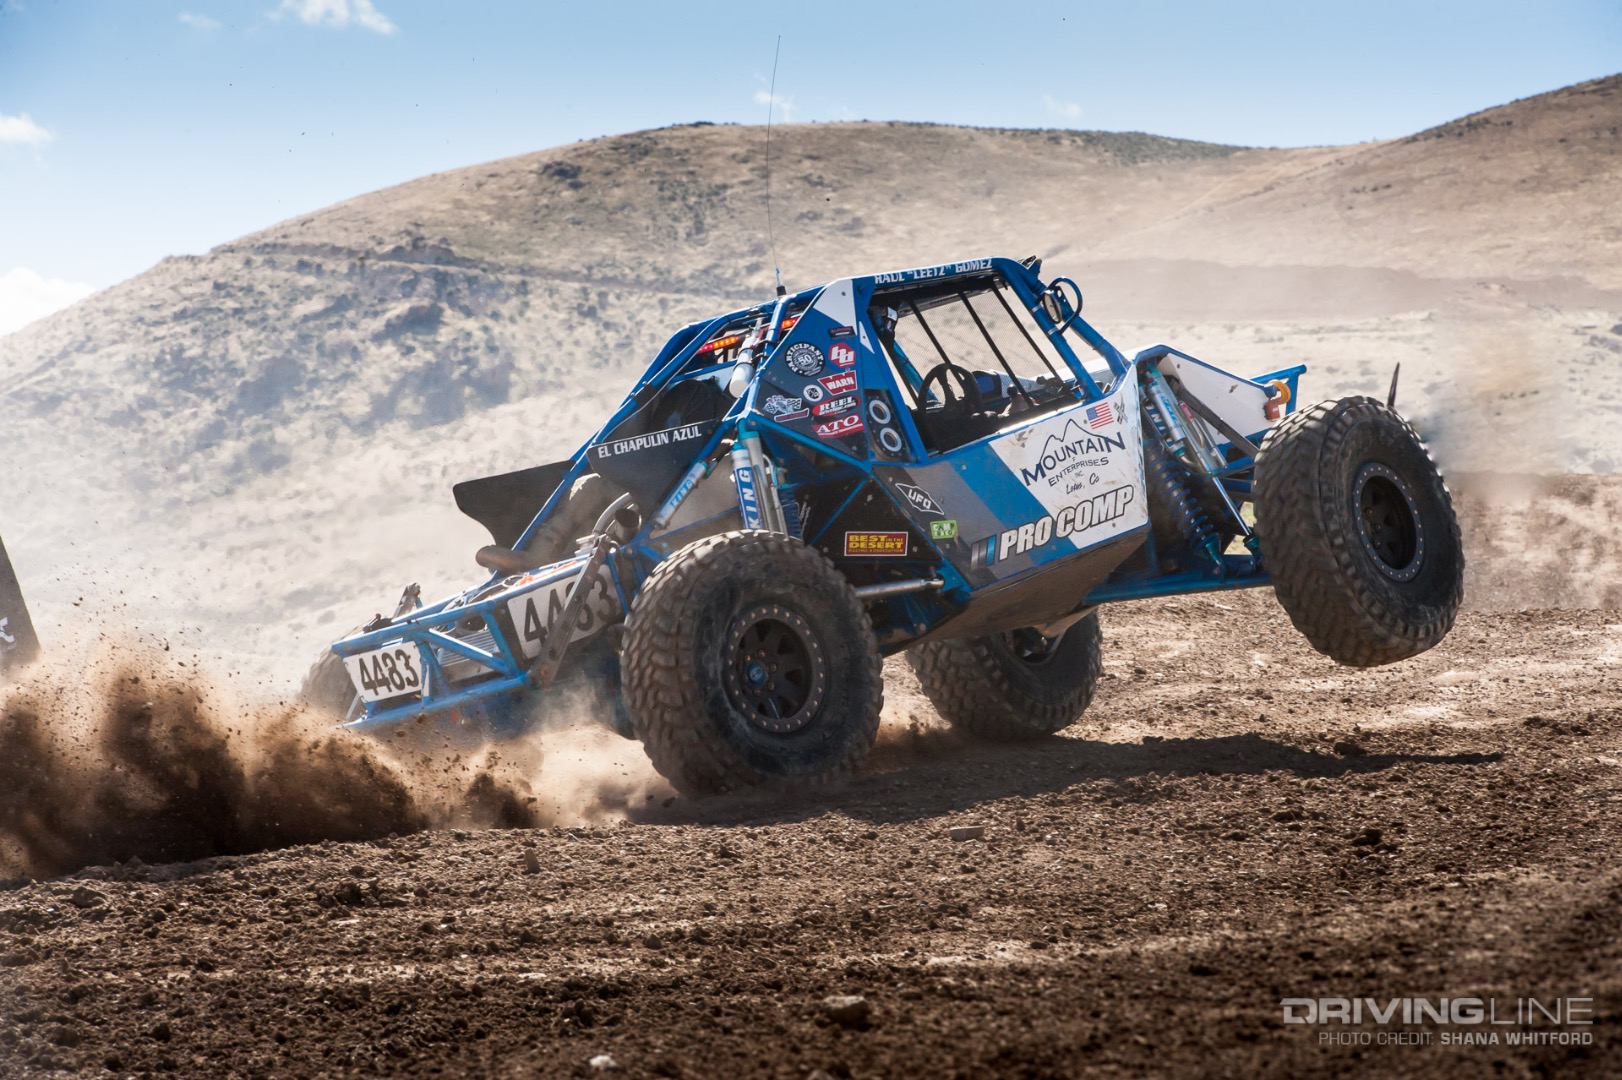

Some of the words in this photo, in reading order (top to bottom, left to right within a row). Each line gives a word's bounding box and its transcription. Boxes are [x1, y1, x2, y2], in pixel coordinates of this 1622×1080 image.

[874, 272, 905, 284] RAUL
[955, 258, 993, 274] GOMEZ
[786, 343, 824, 373] PARTICIPANT
[826, 377, 855, 390] WARN
[819, 396, 855, 411] REEL
[817, 415, 860, 433] ATO
[598, 445, 611, 459] EL
[613, 432, 669, 455] CHAPULIN
[673, 425, 702, 442] AZUL
[1020, 431, 1127, 487] MOUNTAIN
[1048, 456, 1110, 488] ENTERPRISES
[671, 479, 693, 508] KING
[738, 469, 761, 529] KING
[908, 488, 932, 510] UFO
[998, 515, 1053, 563] PRO
[1056, 484, 1135, 539] COMP
[848, 541, 904, 549] DESERT
[359, 648, 420, 697] 4483
